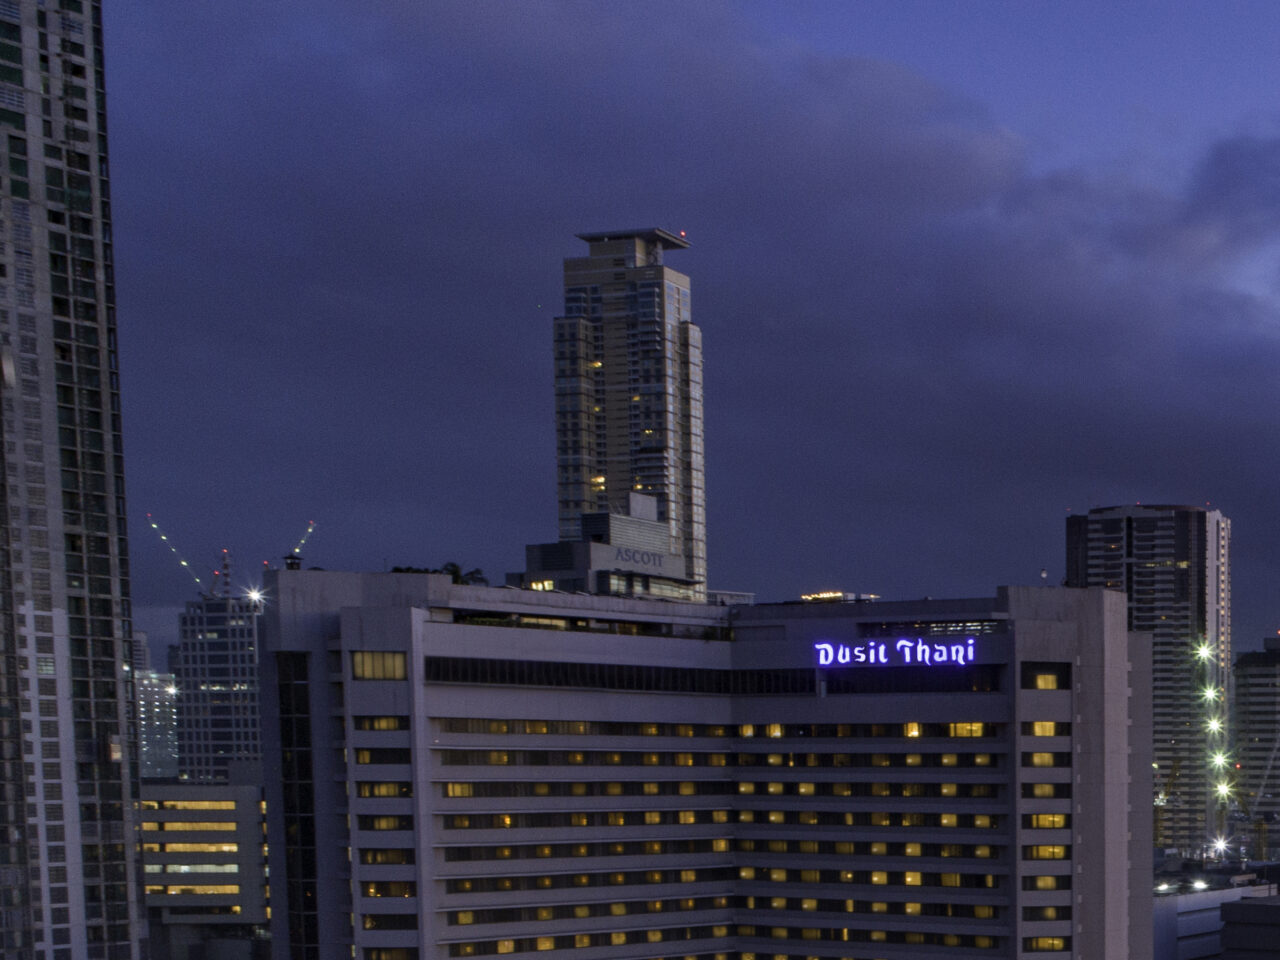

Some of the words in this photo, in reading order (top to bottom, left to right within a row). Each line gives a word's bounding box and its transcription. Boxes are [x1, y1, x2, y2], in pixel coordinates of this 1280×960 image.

[615, 547, 664, 567] ASCOTT
[814, 641, 888, 665] Dusit
[896, 638, 975, 666] Thani
